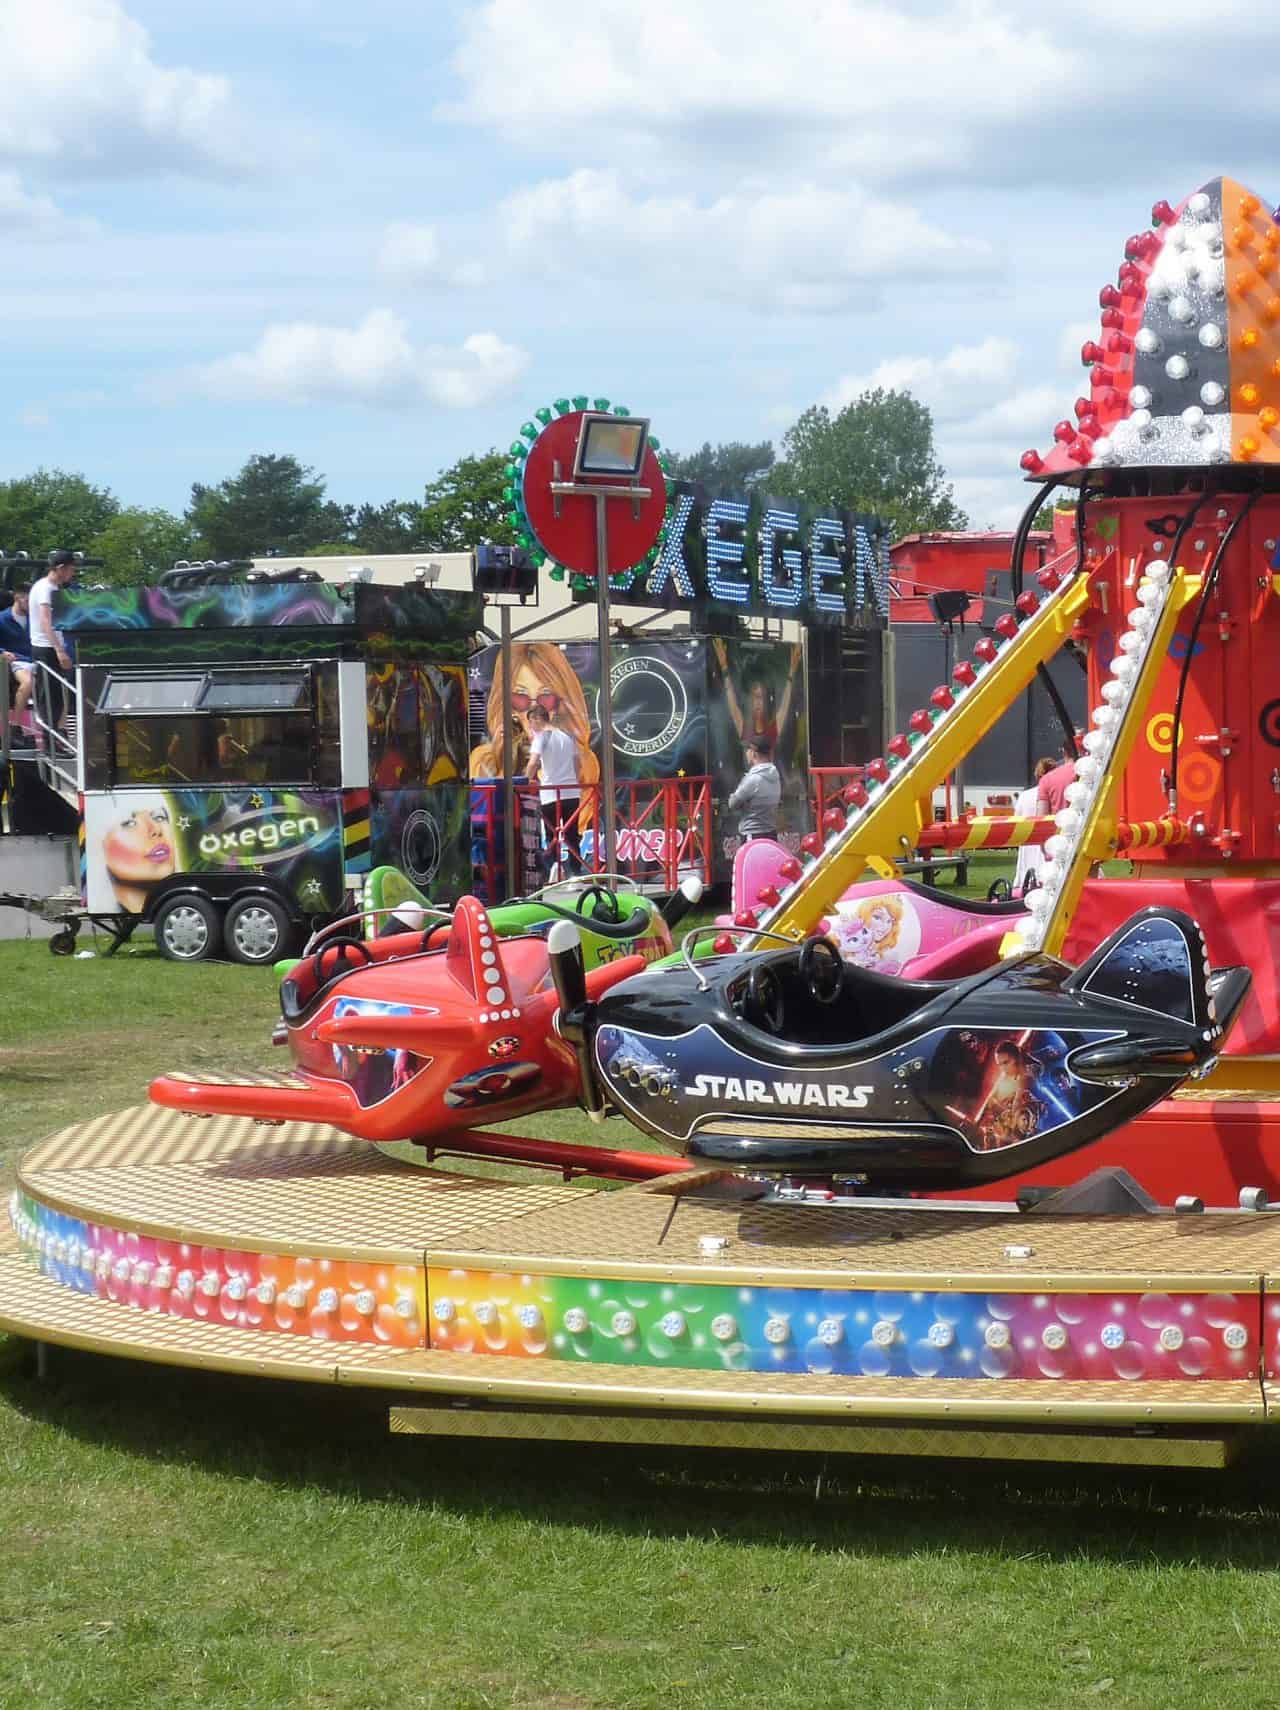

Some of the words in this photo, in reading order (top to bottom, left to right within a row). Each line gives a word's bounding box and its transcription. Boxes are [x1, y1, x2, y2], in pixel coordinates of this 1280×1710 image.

[586, 494, 890, 616] XEGEN
[199, 816, 319, 853] öxegen
[685, 1074, 774, 1104] STAR
[772, 1081, 874, 1108] WARS
